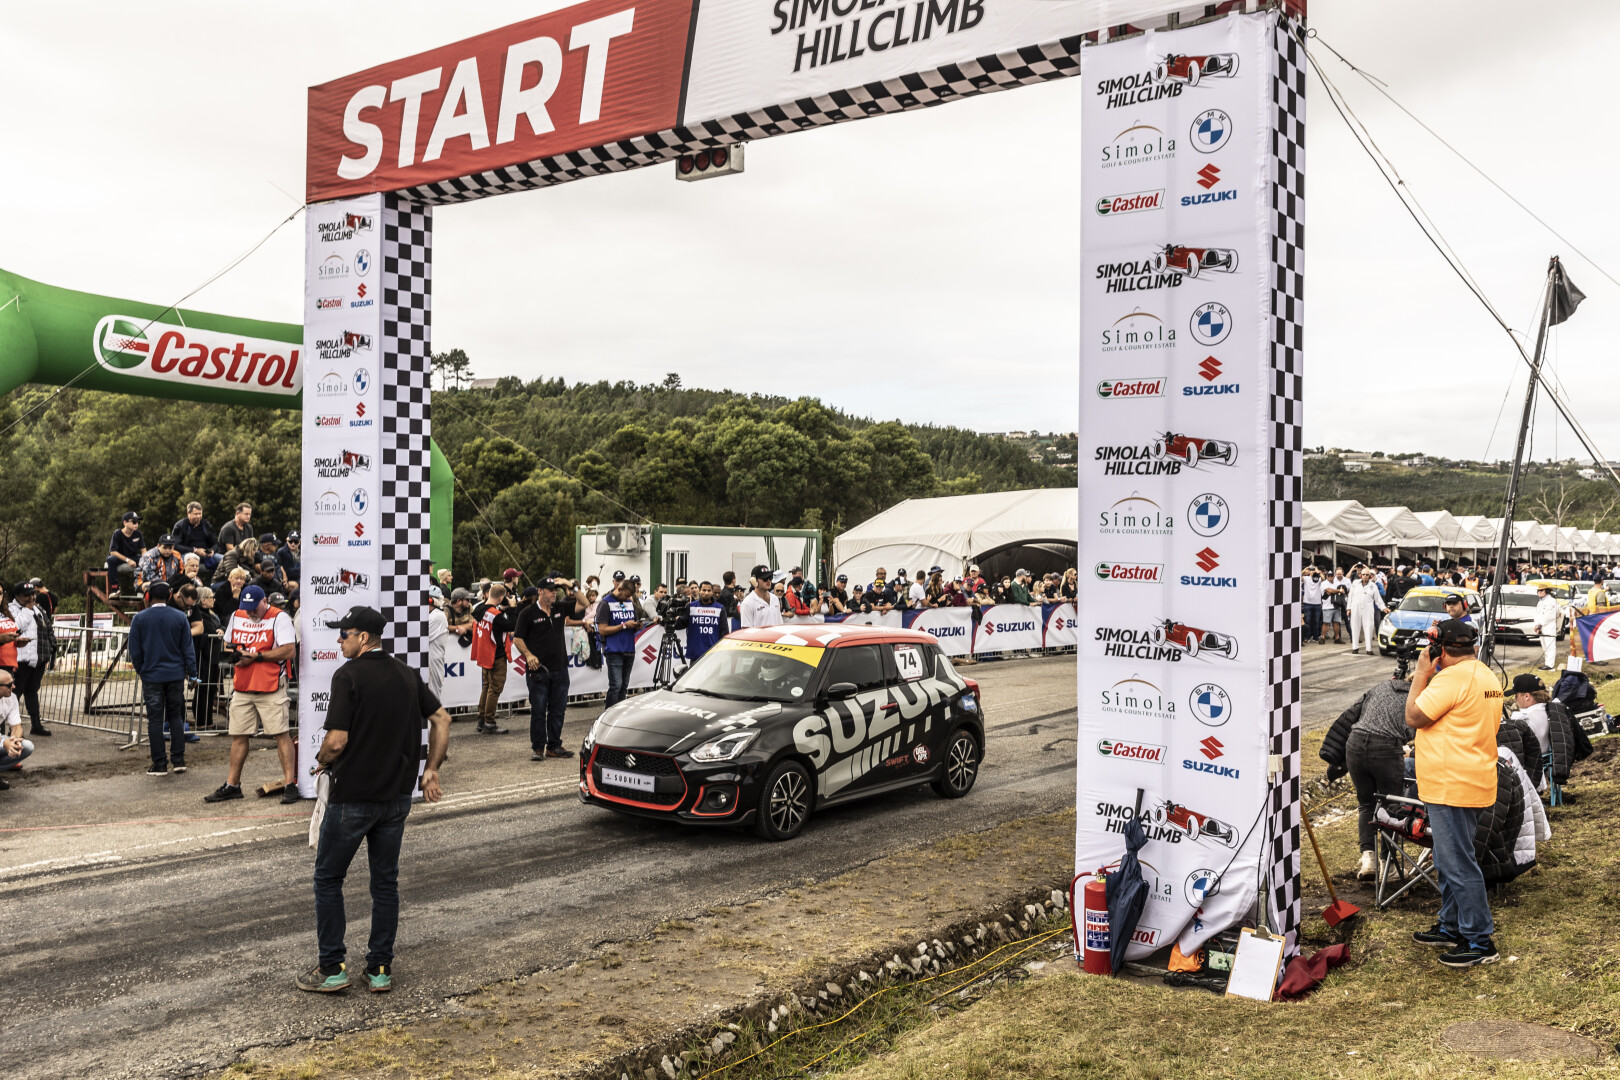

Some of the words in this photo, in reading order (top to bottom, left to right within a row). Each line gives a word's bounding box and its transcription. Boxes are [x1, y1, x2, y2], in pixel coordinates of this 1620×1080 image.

[770, 0, 891, 35] SIM
[793, 0, 984, 72] HILLCLIMB
[1097, 71, 1152, 95] SIMOLA
[336, 7, 636, 180] START
[1106, 82, 1183, 109] HILLCLIMB
[1196, 111, 1226, 126] BMW
[1102, 137, 1175, 162] Simola
[1112, 192, 1159, 212] Castrol
[1181, 190, 1237, 206] SUZUKI
[318, 222, 341, 233] SIMOLA
[321, 231, 352, 242] HILLCLIMB
[1096, 260, 1151, 278] SIMOLA
[1106, 273, 1182, 293] HILLCLIMB
[322, 298, 342, 308] Castrol
[351, 300, 373, 308] SUZUKI
[1196, 304, 1226, 317] BMW
[1102, 326, 1176, 344] Simola
[316, 340, 339, 350] SIMOLA
[150, 331, 299, 388] Castrol
[320, 349, 350, 359] HILLCLIMB
[1113, 380, 1160, 396] Castrol
[1183, 384, 1239, 396] SUZUKI
[321, 416, 341, 426] Castrol
[350, 419, 372, 427] SUZUKI
[1095, 446, 1150, 460] SIMOLA
[314, 458, 337, 468] SIMOLA
[1104, 461, 1181, 475] HILLCLIMB
[317, 468, 349, 477] HILLCLIMB
[1193, 496, 1224, 507] BMW
[1100, 512, 1173, 527] Simola
[320, 534, 339, 545] Castrol
[1111, 565, 1158, 580] Castrol
[311, 576, 335, 585] SIMOLA
[1180, 575, 1236, 587] SUZUKI
[314, 584, 347, 595] HILLCLIMB
[612, 612, 634, 620] MEDIA
[692, 616, 718, 625] MEDIA
[700, 626, 713, 634] 108
[928, 626, 965, 637] SUZUKI
[997, 622, 1035, 632] SUZUKI
[234, 632, 268, 644] MEDIA
[1095, 627, 1150, 644] SIMOLA
[740, 643, 793, 651] DUNLOP
[1104, 643, 1182, 662] HILLCLIMB
[318, 651, 338, 660] Castrol
[899, 652, 916, 669] 74
[311, 692, 330, 702] SIMOL
[1195, 685, 1225, 699] BMW
[1484, 690, 1503, 699] MARSH
[1102, 691, 1176, 712] Simola
[792, 654, 967, 769] SUZUKI
[1113, 742, 1161, 761] Castrol
[886, 755, 909, 766] SWIFT
[1183, 760, 1239, 779] SUZUKI
[1096, 802, 1151, 823] SIMOA
[1105, 819, 1182, 843] HILIMB
[1130, 929, 1155, 944] trol
